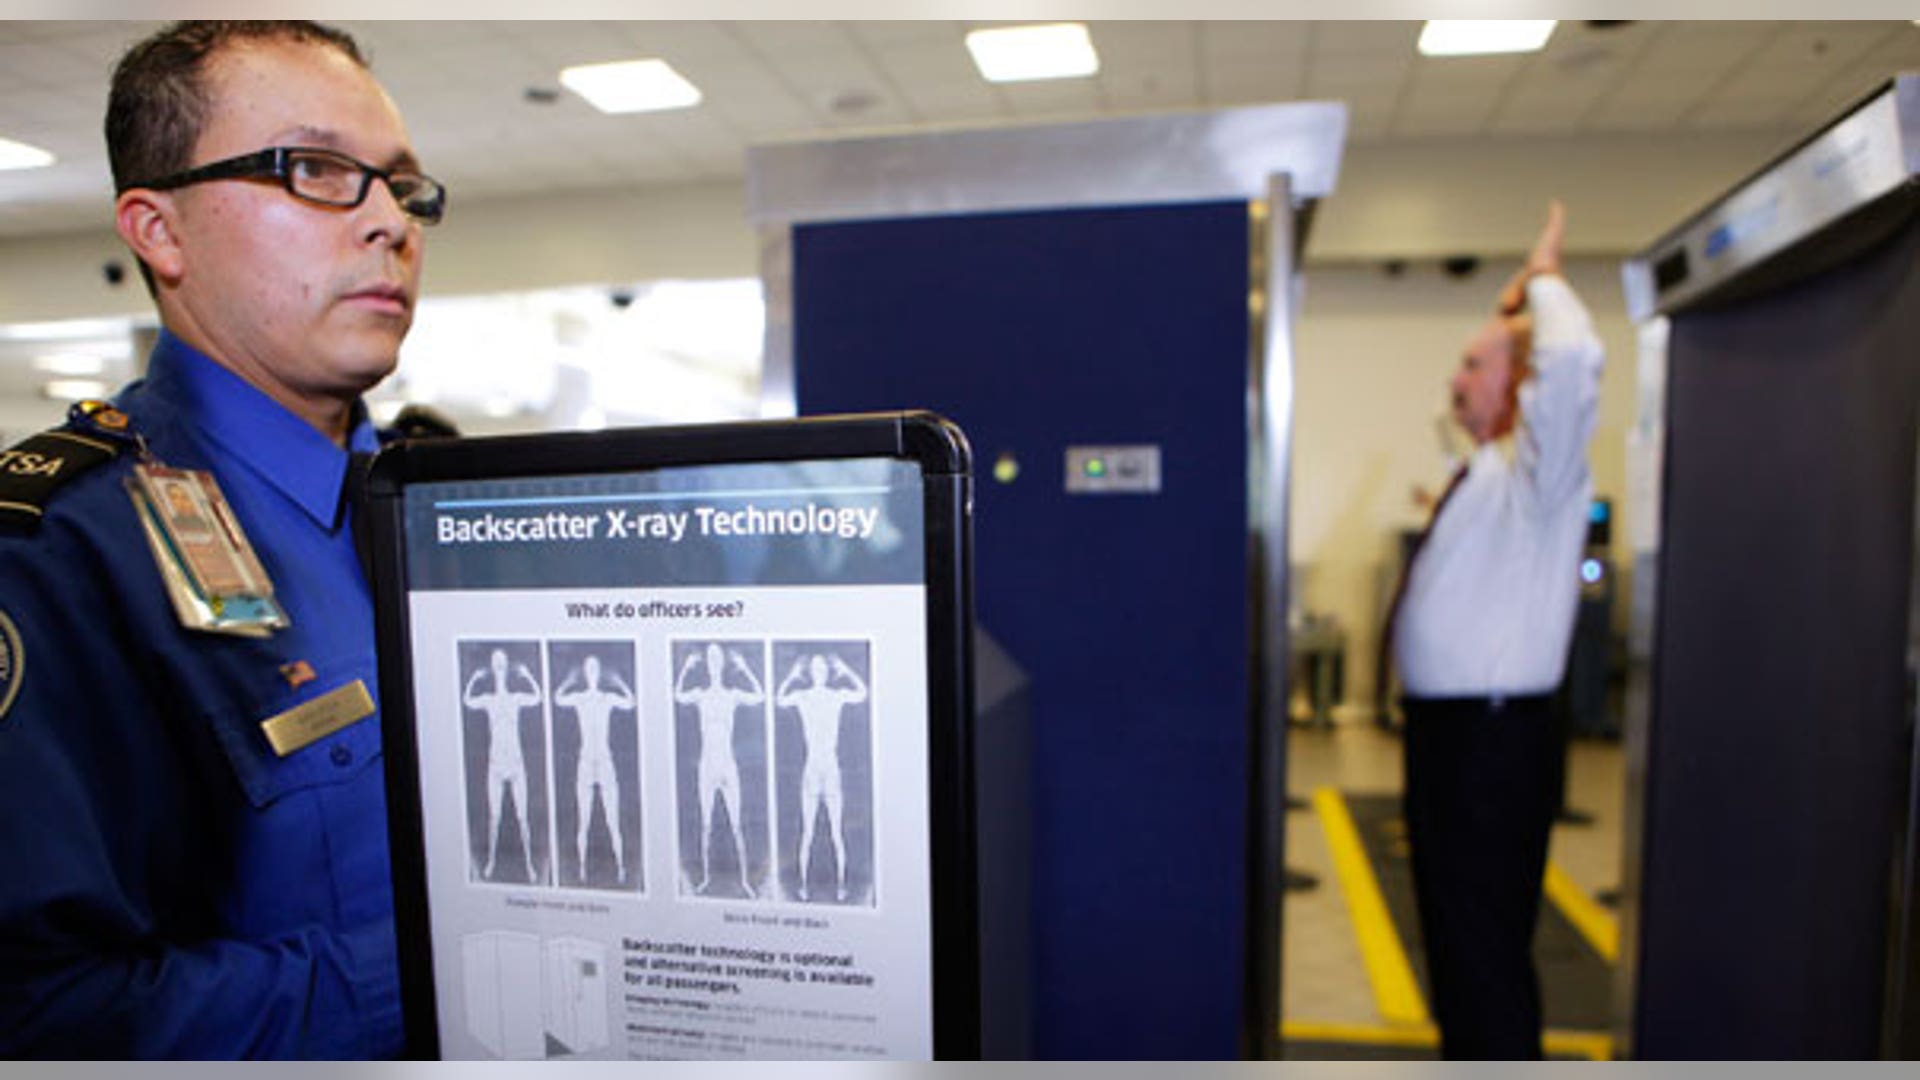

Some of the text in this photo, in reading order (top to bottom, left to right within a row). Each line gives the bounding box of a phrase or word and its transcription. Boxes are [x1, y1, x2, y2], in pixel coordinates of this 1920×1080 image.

[0, 451, 65, 476] TSA
[437, 503, 879, 543] Backscatter X-ray Technology
[565, 601, 744, 618] What do officers see?
[622, 938, 853, 967] Backscatter technology is optional
[624, 956, 648, 968] and
[650, 958, 722, 975] alternative
[726, 965, 791, 983] screening
[810, 971, 874, 987] available
[624, 972, 643, 985] for
[665, 978, 741, 993] passengers.
